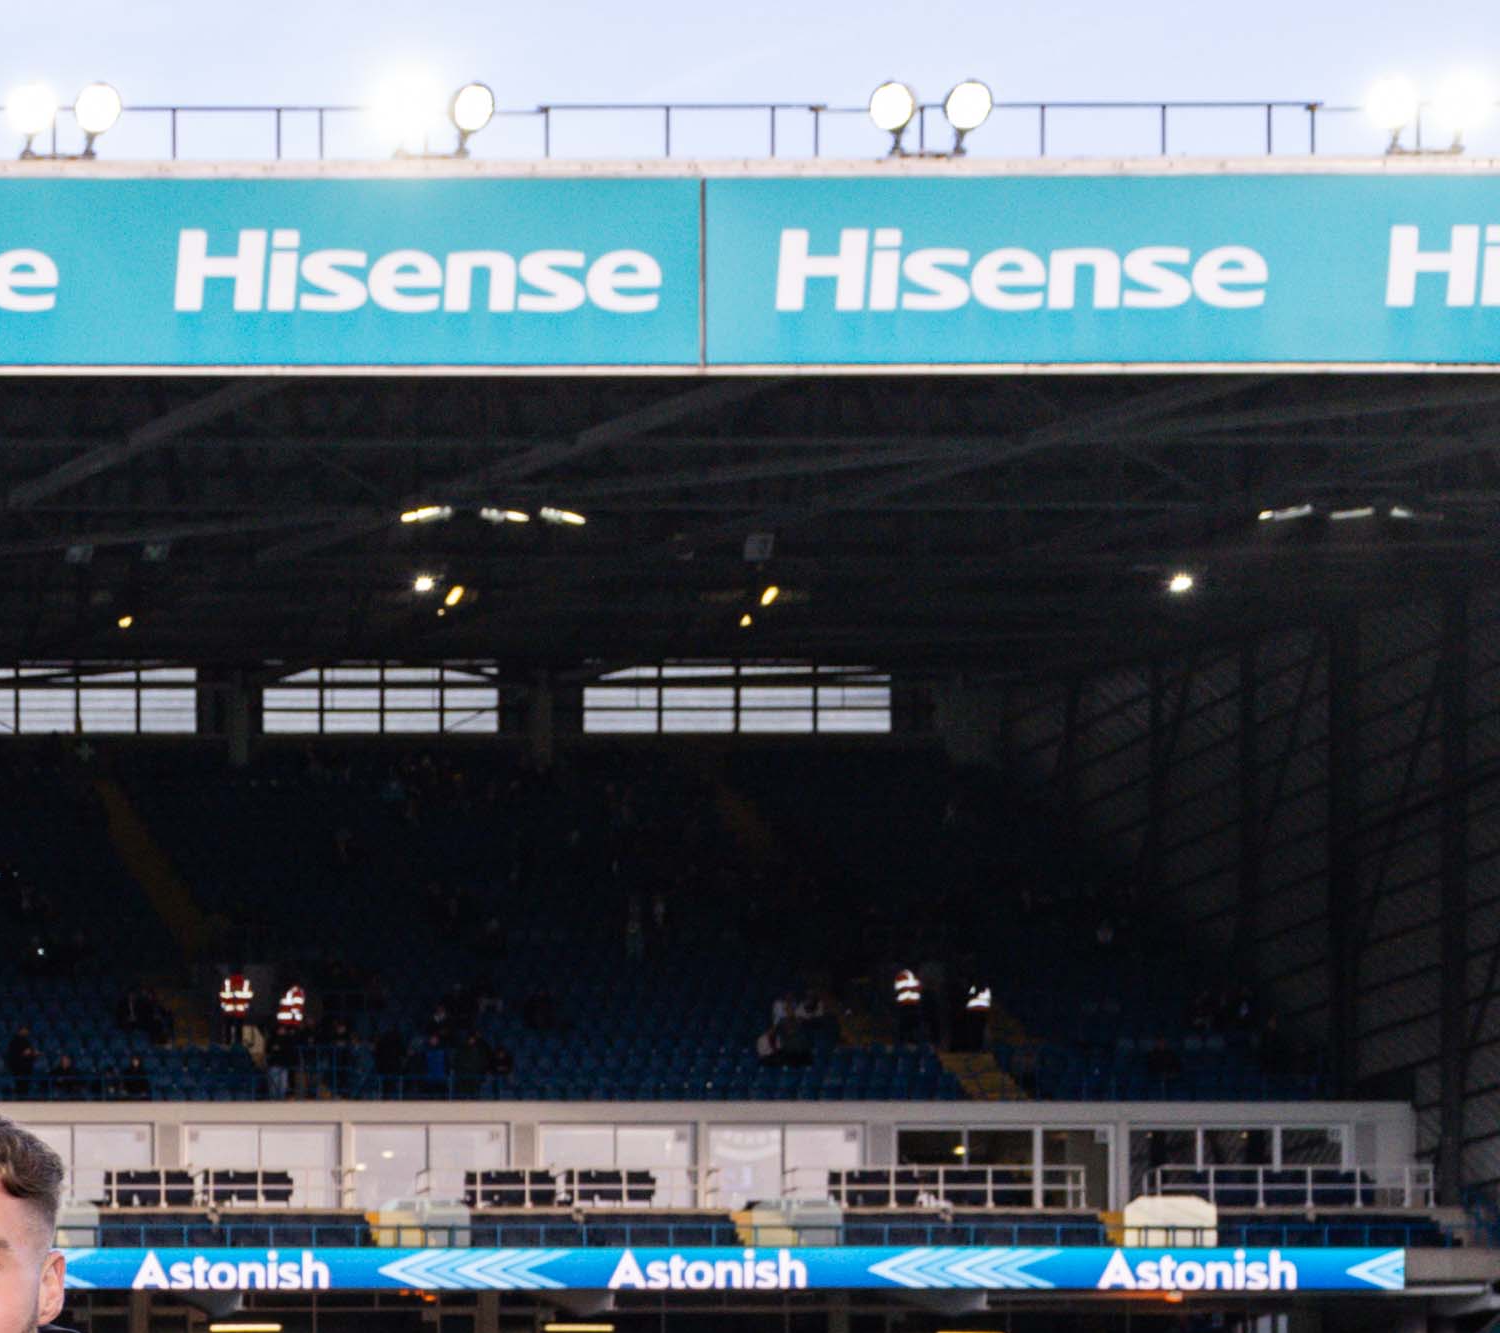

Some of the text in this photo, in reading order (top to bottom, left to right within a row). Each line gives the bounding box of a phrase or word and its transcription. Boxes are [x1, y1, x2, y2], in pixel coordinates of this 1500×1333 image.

[173, 227, 663, 314] Hisense
[774, 226, 1270, 312] Hisense
[132, 1250, 329, 1290] Astonish
[609, 1248, 806, 1289] Astonish
[1098, 1249, 1297, 1290] Astonish
